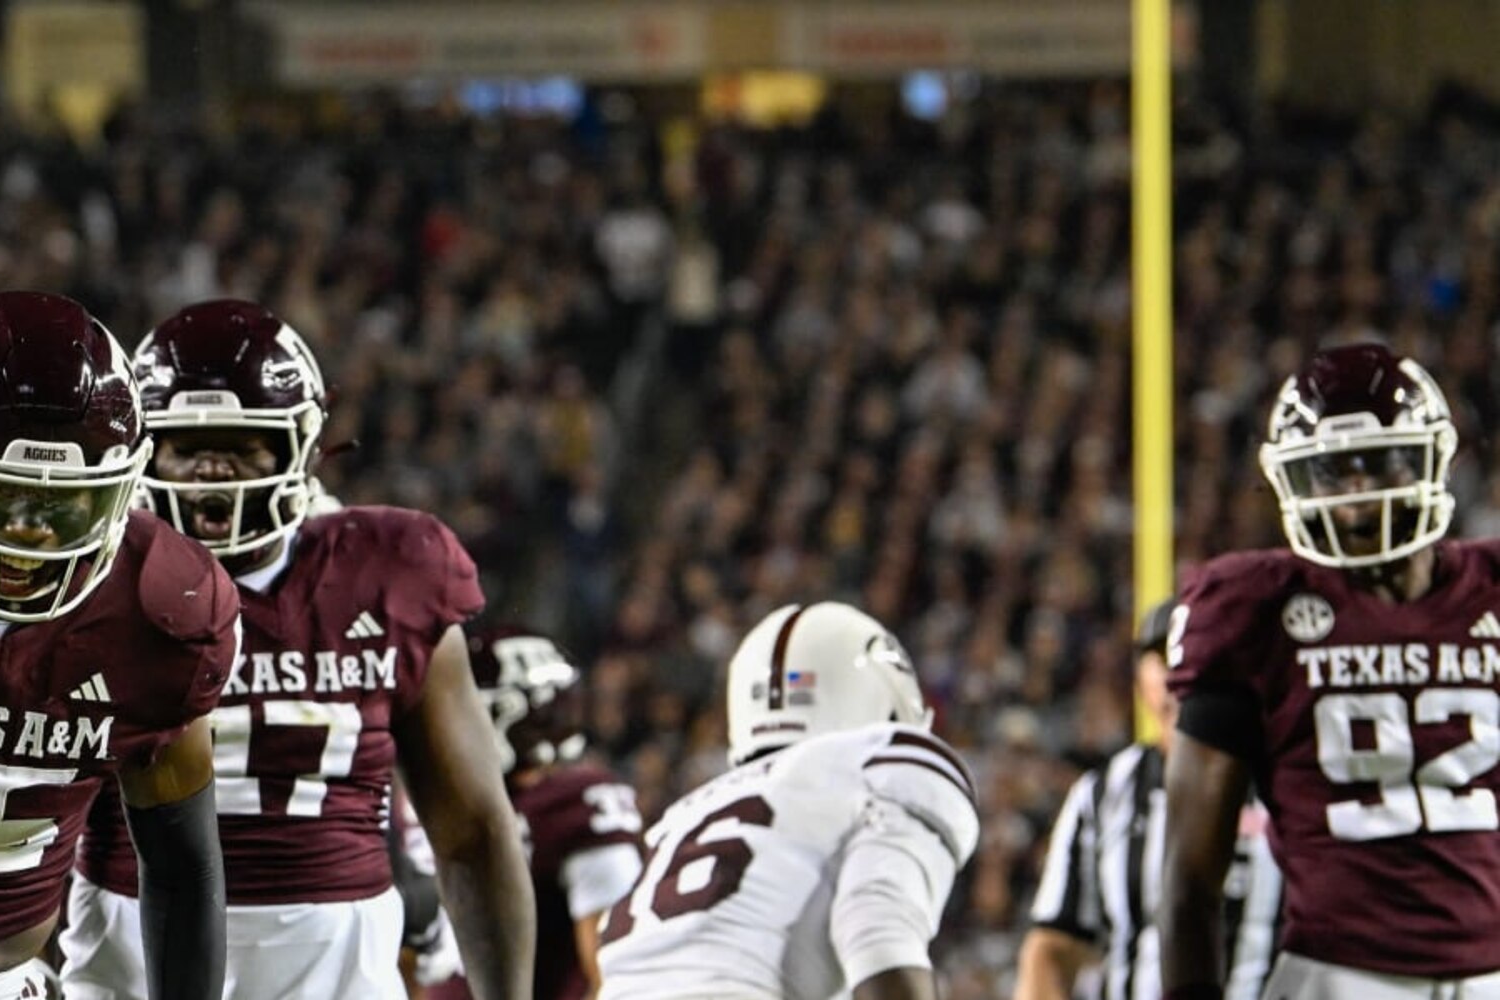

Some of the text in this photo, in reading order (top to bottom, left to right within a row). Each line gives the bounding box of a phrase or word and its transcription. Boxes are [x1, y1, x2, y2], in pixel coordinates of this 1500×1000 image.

[23, 446, 67, 462] AGGIES
[314, 647, 398, 693] A&M
[1296, 643, 1430, 688] TEXAS
[14, 711, 114, 760] A&M
[211, 700, 362, 817] 17
[1314, 689, 1500, 841] 92
[601, 795, 775, 946] 16
